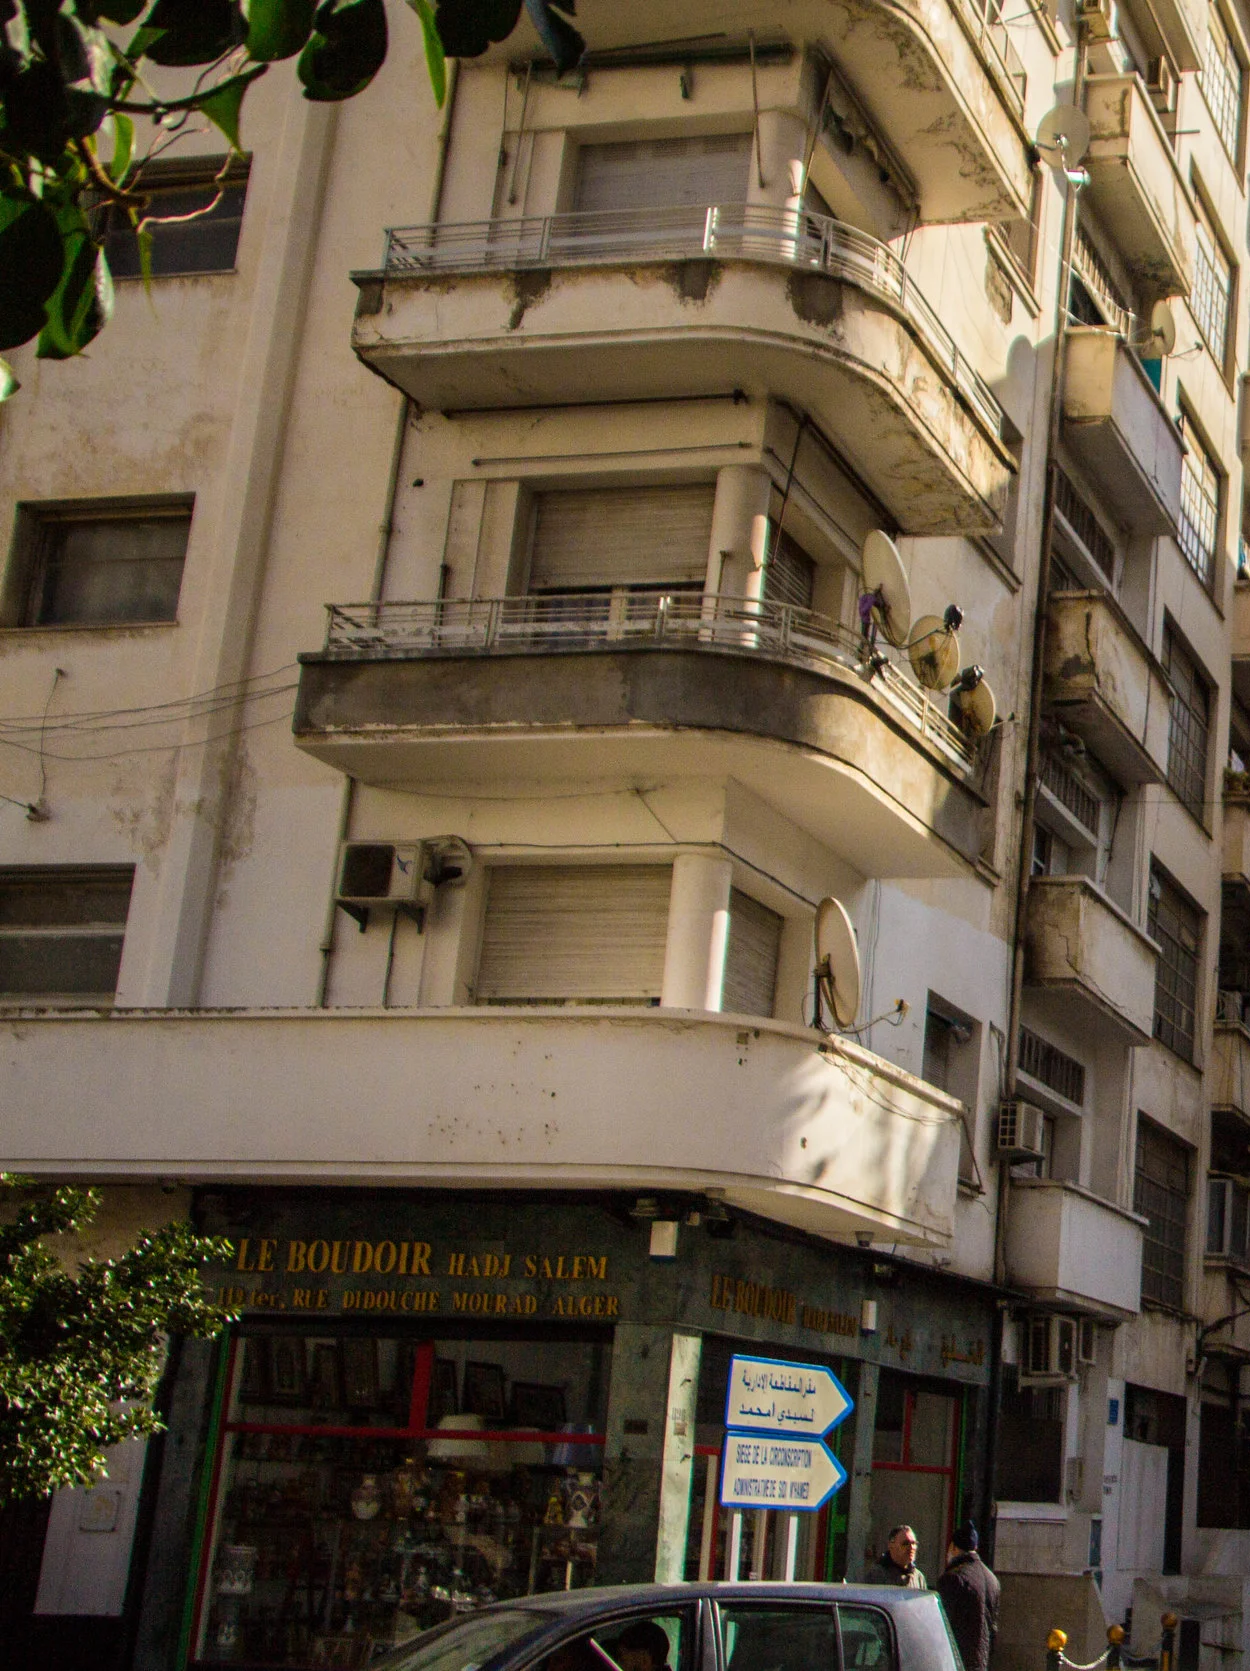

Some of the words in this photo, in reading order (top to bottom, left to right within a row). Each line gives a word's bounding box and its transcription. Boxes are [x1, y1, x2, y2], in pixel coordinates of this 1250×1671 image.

[236, 1238, 277, 1273] LE
[286, 1239, 432, 1276] BOUDOIR
[448, 1252, 511, 1279] HADJ
[524, 1254, 608, 1280] SALEM
[292, 1287, 329, 1309] RUE
[342, 1290, 441, 1312] DIDOUCHE
[453, 1291, 537, 1314] MOURAD
[551, 1295, 619, 1317] ALGER
[710, 1274, 732, 1311] LE
[734, 1279, 797, 1326] BOUDOIR
[768, 1373, 803, 1393] المقاطعة
[802, 1377, 817, 1399] مقر
[777, 1407, 815, 1426] لسيدي
[752, 1445, 761, 1465] DE
[761, 1446, 768, 1465] LA
[769, 1446, 813, 1469] CIRCONSCRIPTION
